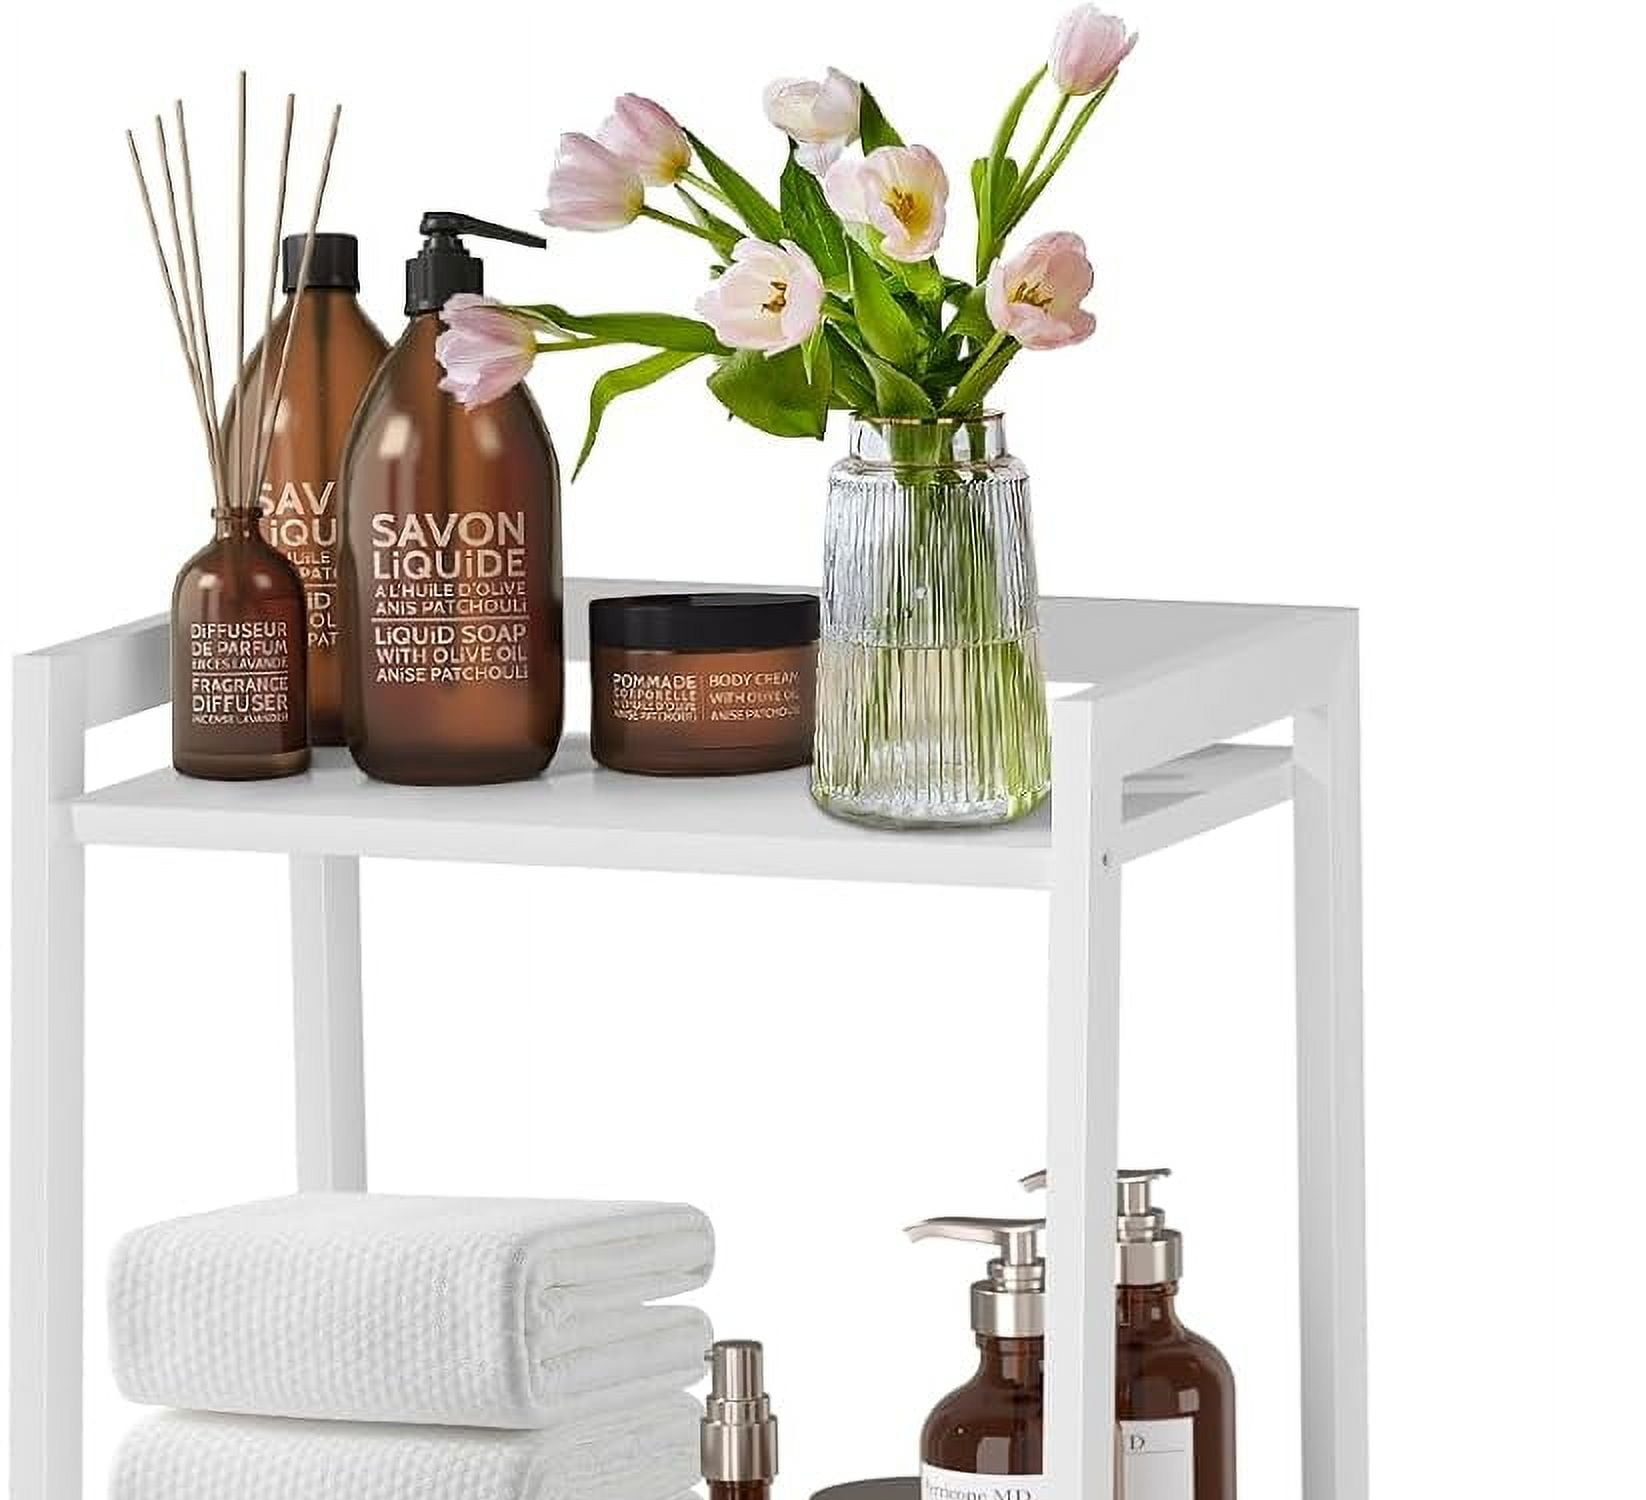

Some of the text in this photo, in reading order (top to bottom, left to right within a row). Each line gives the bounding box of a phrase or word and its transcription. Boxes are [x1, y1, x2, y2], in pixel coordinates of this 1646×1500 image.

[372, 512, 525, 547] SAVON
[373, 549, 526, 580] LiQUiDE
[375, 624, 526, 645] LiQUiD SOAP
[192, 639, 288, 657] DE PARFUM
[192, 677, 288, 693] FRAGRANCE
[613, 673, 697, 689] POMMADE
[709, 673, 753, 687] BODY
